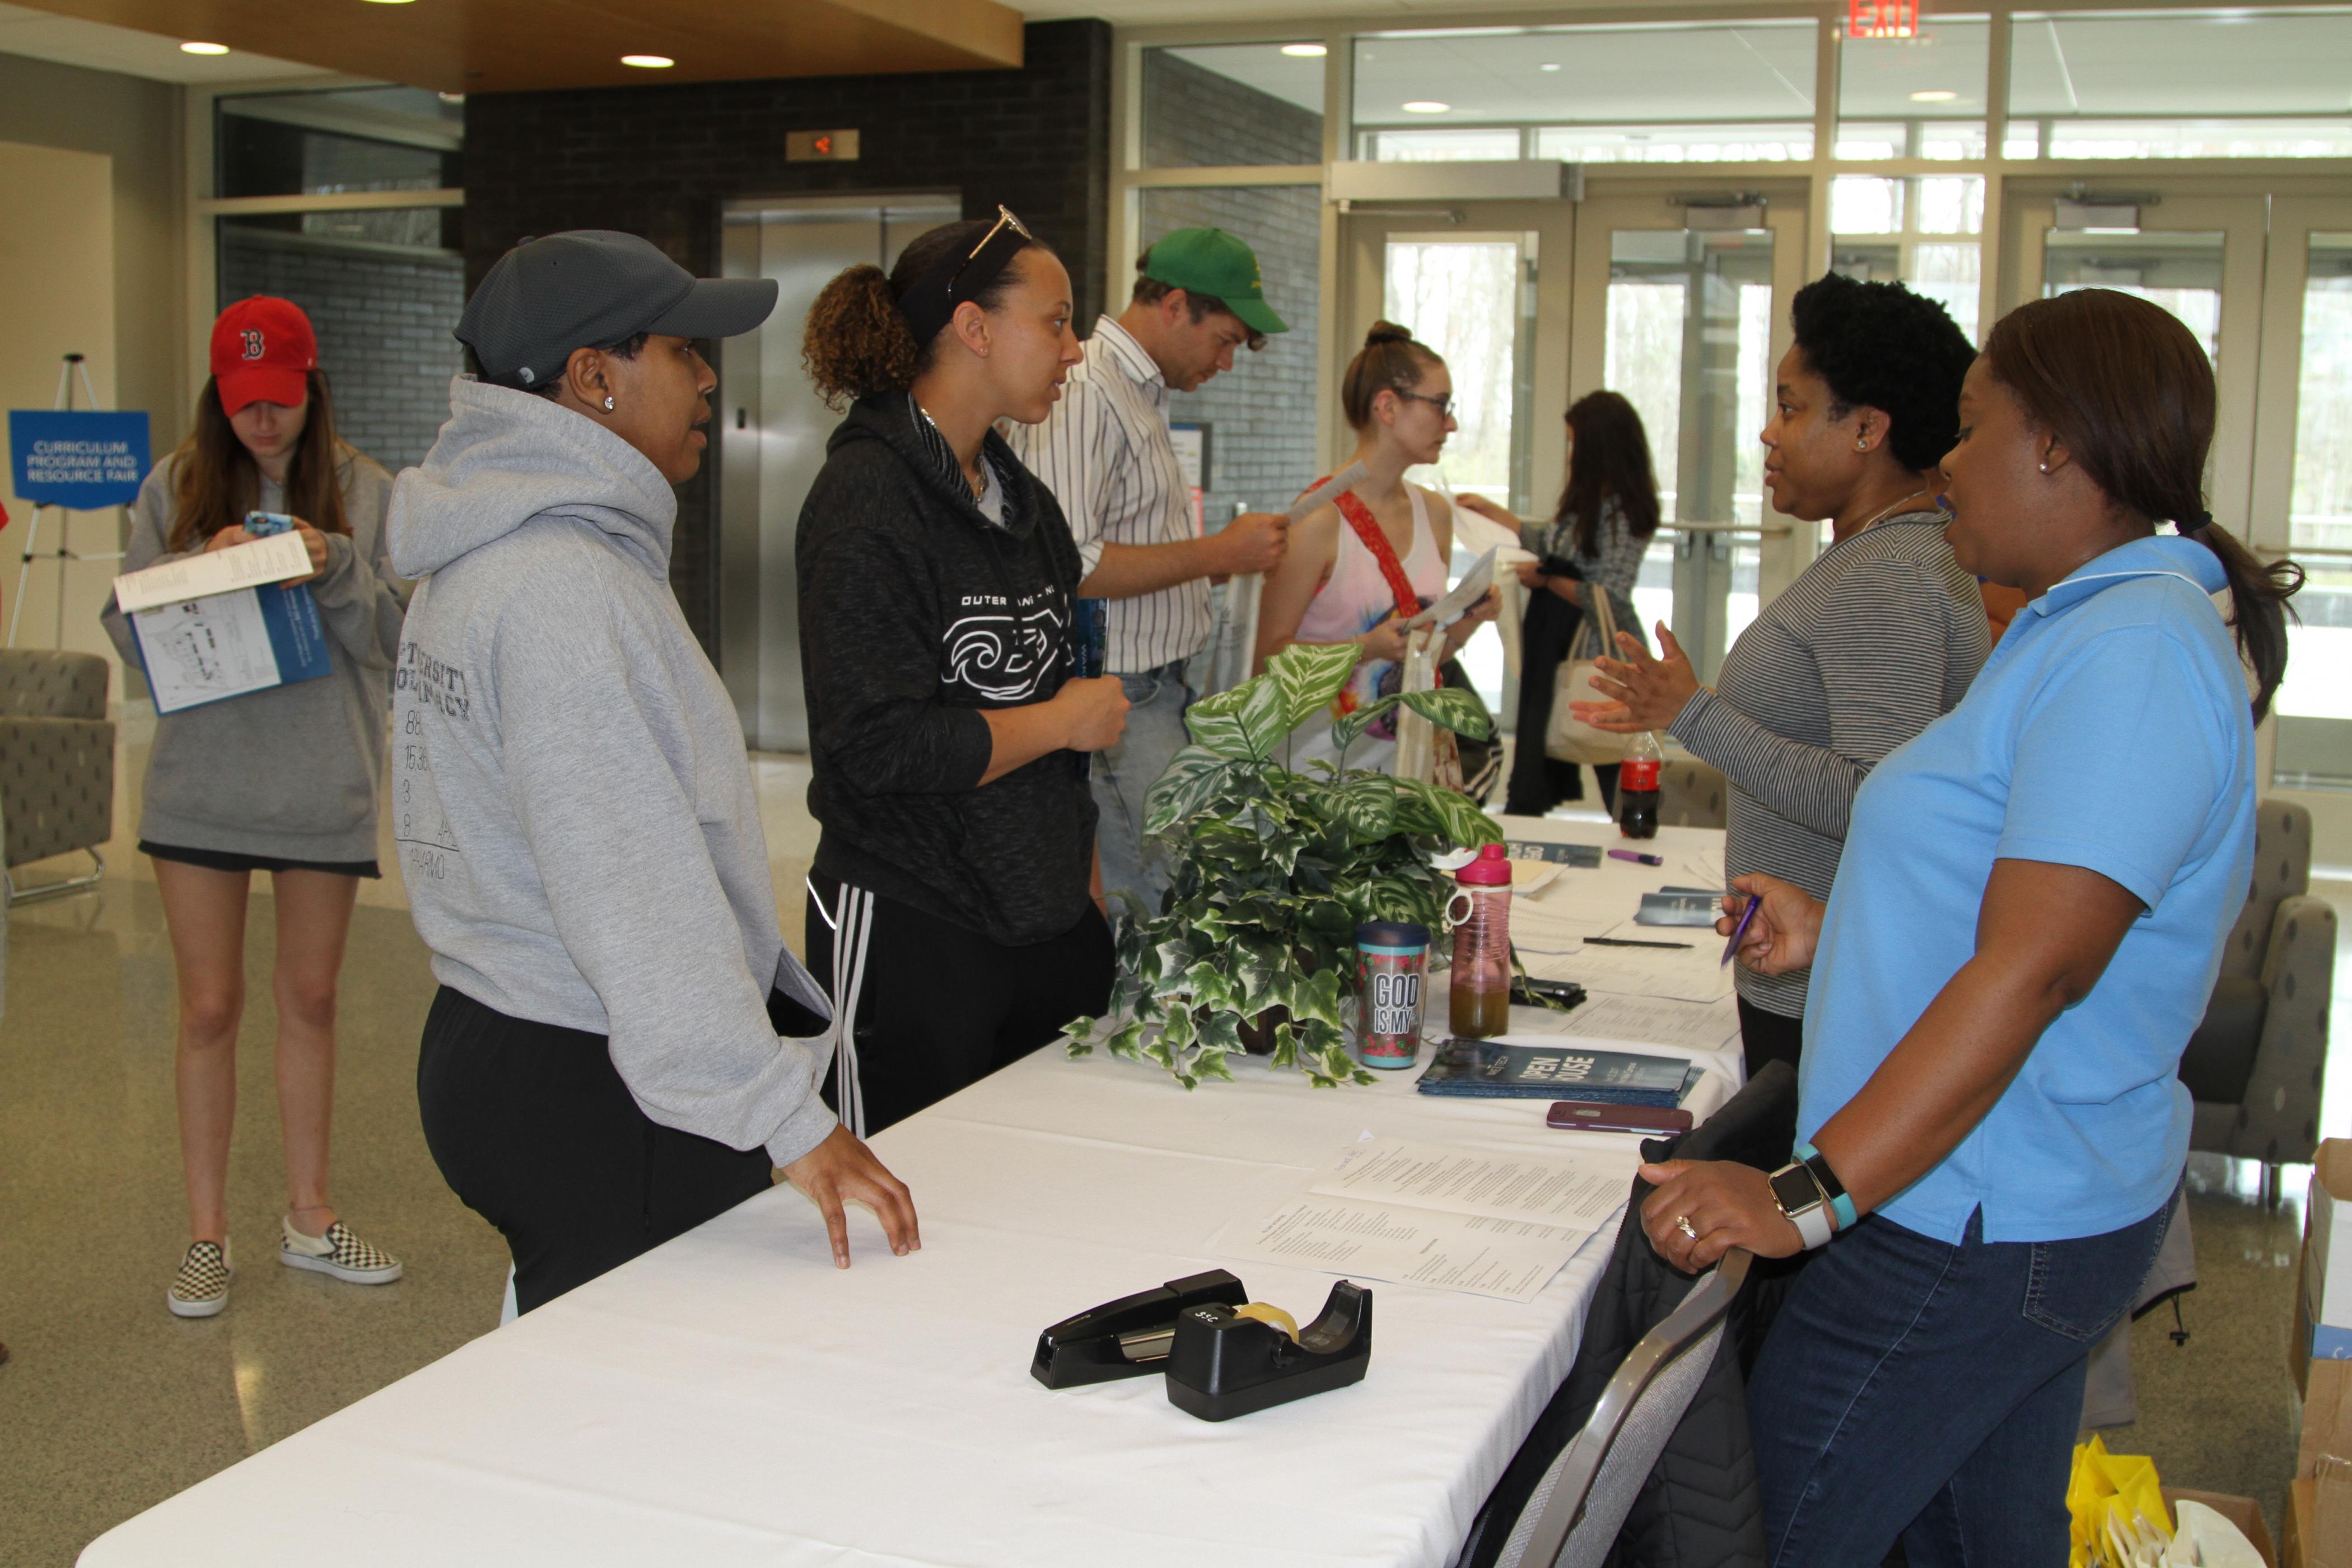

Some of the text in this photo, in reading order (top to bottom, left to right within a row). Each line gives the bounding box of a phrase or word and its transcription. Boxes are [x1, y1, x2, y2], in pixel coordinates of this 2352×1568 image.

[240, 329, 265, 360] B
[33, 441, 128, 455] CURRICULUM
[27, 454, 138, 469] PROGRAM AND
[27, 468, 138, 483] RESOURCE FAIR
[962, 595, 1007, 606] OUTER
[1374, 973, 1420, 1009] GOD
[1374, 1009, 1413, 1034] IS MY
[1519, 1056, 1561, 1080] OPEN
[1194, 1312, 1219, 1323] SSC
